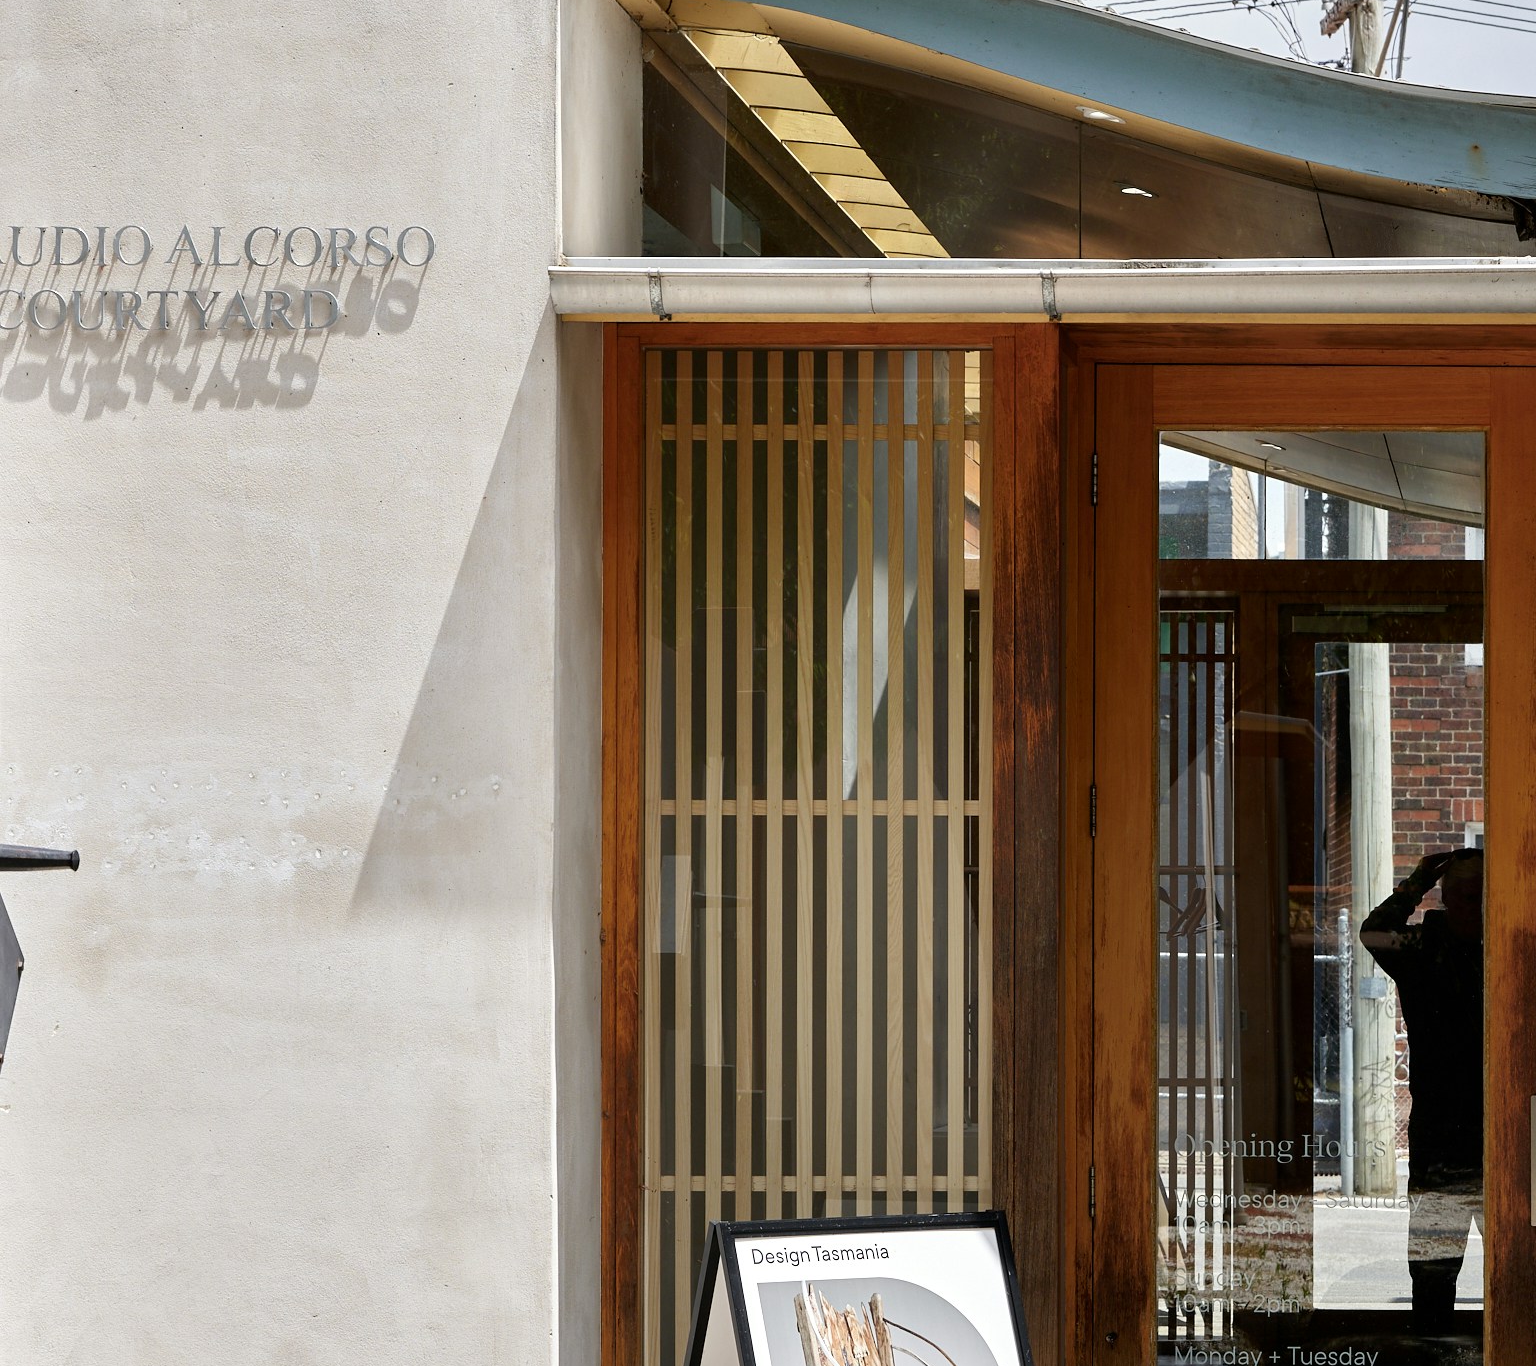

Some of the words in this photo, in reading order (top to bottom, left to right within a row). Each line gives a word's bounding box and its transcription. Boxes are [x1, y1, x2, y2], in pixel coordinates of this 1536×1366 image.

[0, 225, 153, 267] UDIO
[165, 224, 436, 268] ALCORSO
[0, 289, 340, 331] COURTYARD
[1174, 1133, 1294, 1163] Opening
[1301, 1135, 1386, 1158] Hours
[1174, 1190, 1303, 1213] Wednesday
[1325, 1190, 1423, 1214] Saturday
[1174, 1215, 1230, 1235] 10am
[1254, 1216, 1300, 1239] 3pm
[1175, 1268, 1256, 1291] Sunday
[1174, 1294, 1230, 1313] 10am
[1254, 1294, 1300, 1318] 2pm
[1269, 1351, 1281, 1364] +
